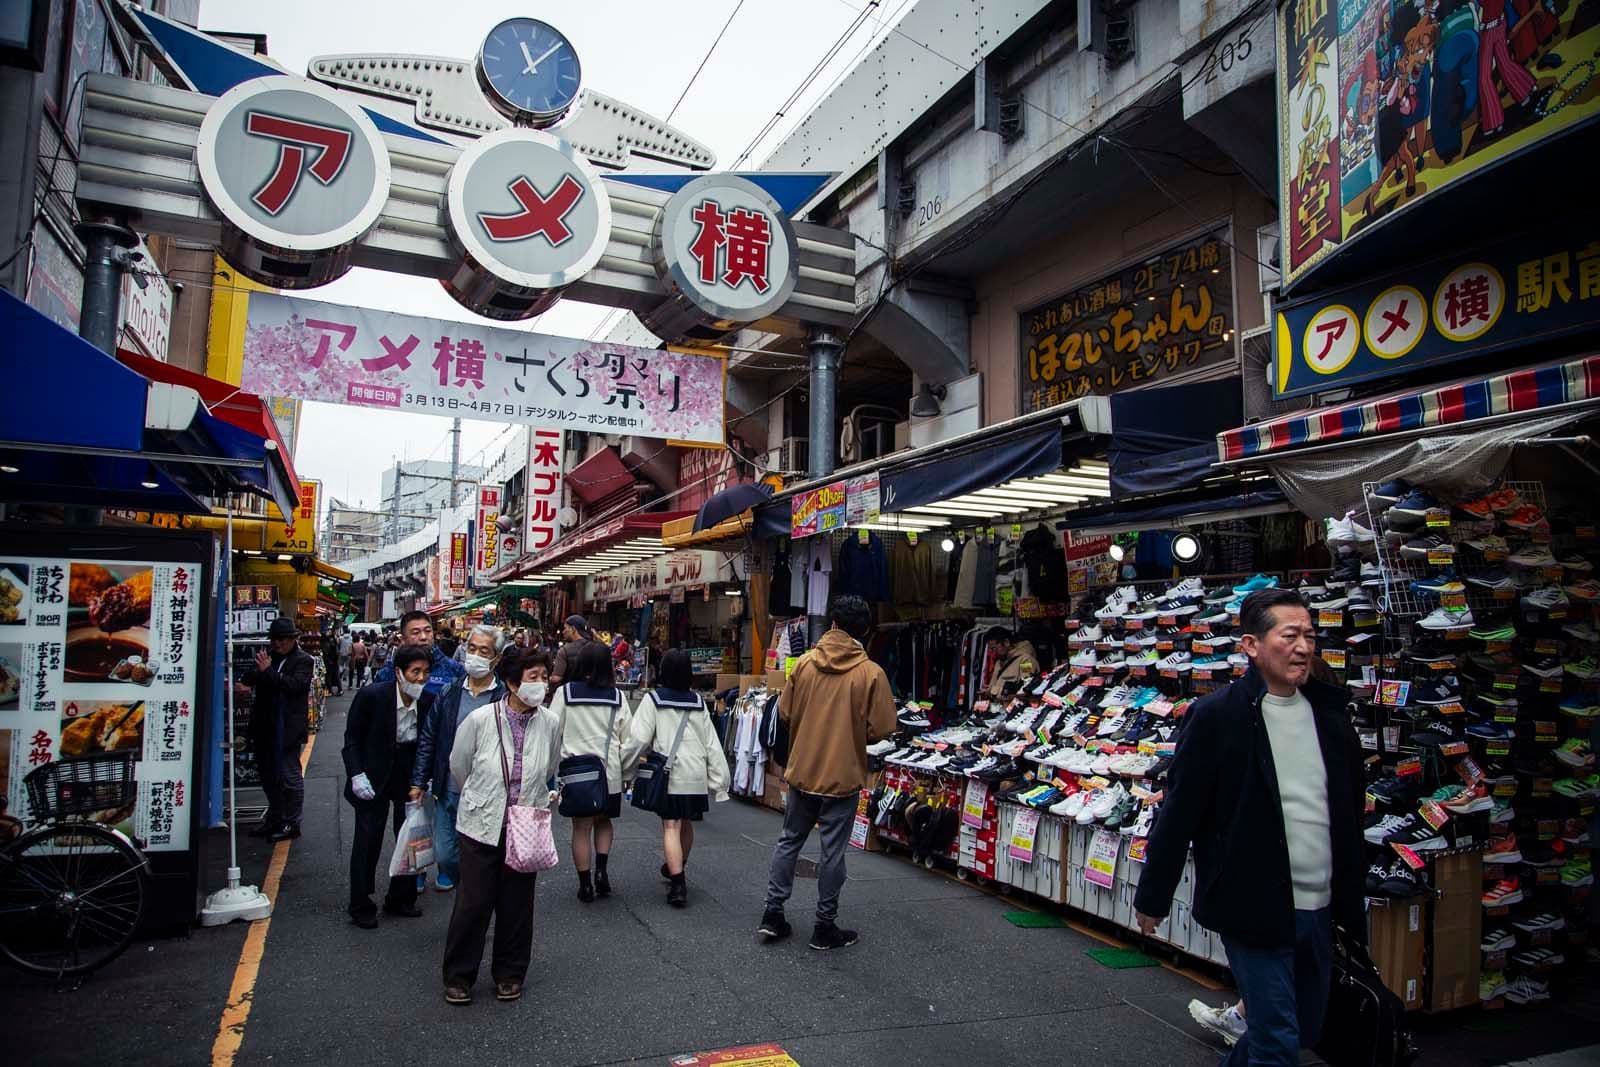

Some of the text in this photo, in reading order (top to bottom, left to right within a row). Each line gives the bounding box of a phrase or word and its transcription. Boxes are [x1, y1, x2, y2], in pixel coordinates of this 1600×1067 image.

[1206, 27, 1252, 84] 205
[247, 111, 773, 294] アメ横
[920, 195, 942, 226] 206
[1031, 241, 1220, 333] ふれあい酒場 2F 74席
[1028, 285, 1213, 382] ほていちゃん
[1315, 274, 1490, 361] アメ横
[305, 318, 681, 414] アメ横 さくら祭り
[351, 386, 397, 403] 開催日時
[288, 539, 308, 549] 入口
[50, 565, 65, 604] ちくわ
[172, 566, 188, 593] 名物
[237, 588, 272, 602] 買取
[36, 614, 61, 622] 190円
[169, 595, 188, 665] 神田旨カツ
[35, 641, 50, 700] ポテトサラダ
[162, 701, 179, 750] 揚げたて
[179, 701, 190, 717] 名物
[29, 730, 53, 766] 名物
